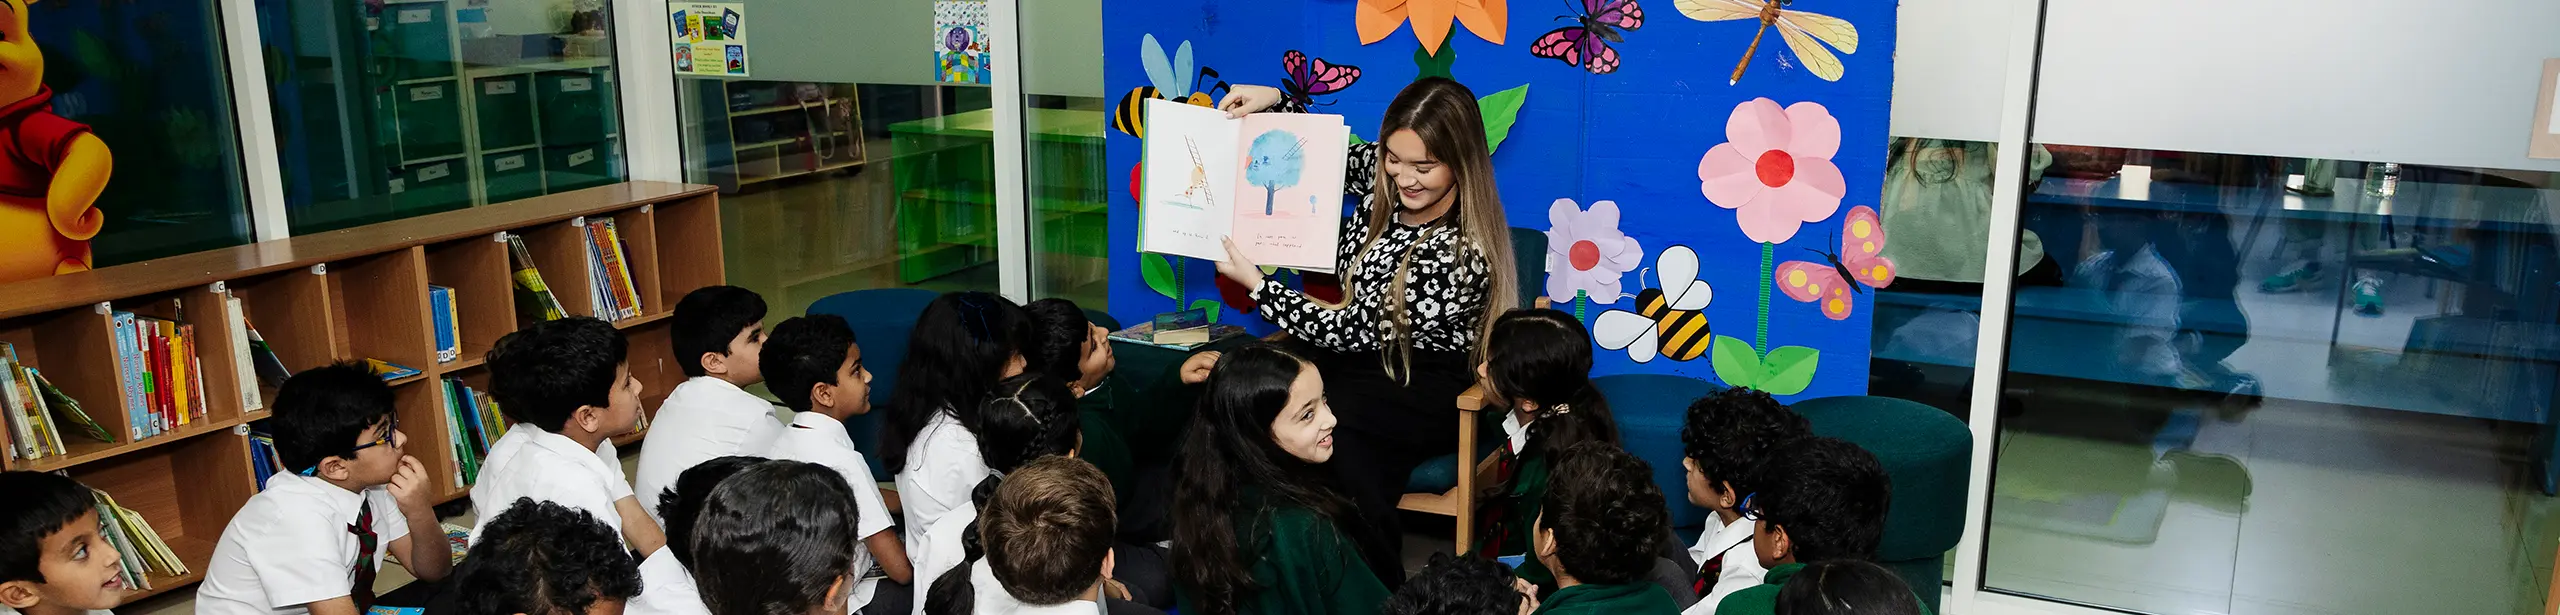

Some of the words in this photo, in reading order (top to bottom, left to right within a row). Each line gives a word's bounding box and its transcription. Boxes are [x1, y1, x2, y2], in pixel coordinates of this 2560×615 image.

[122, 356, 131, 383] Nursery
[132, 353, 140, 380] Nursery
[136, 381, 144, 407] Rhymes
[126, 385, 135, 411] Rhymes
[153, 420, 158, 428] C
[242, 425, 248, 433] D
